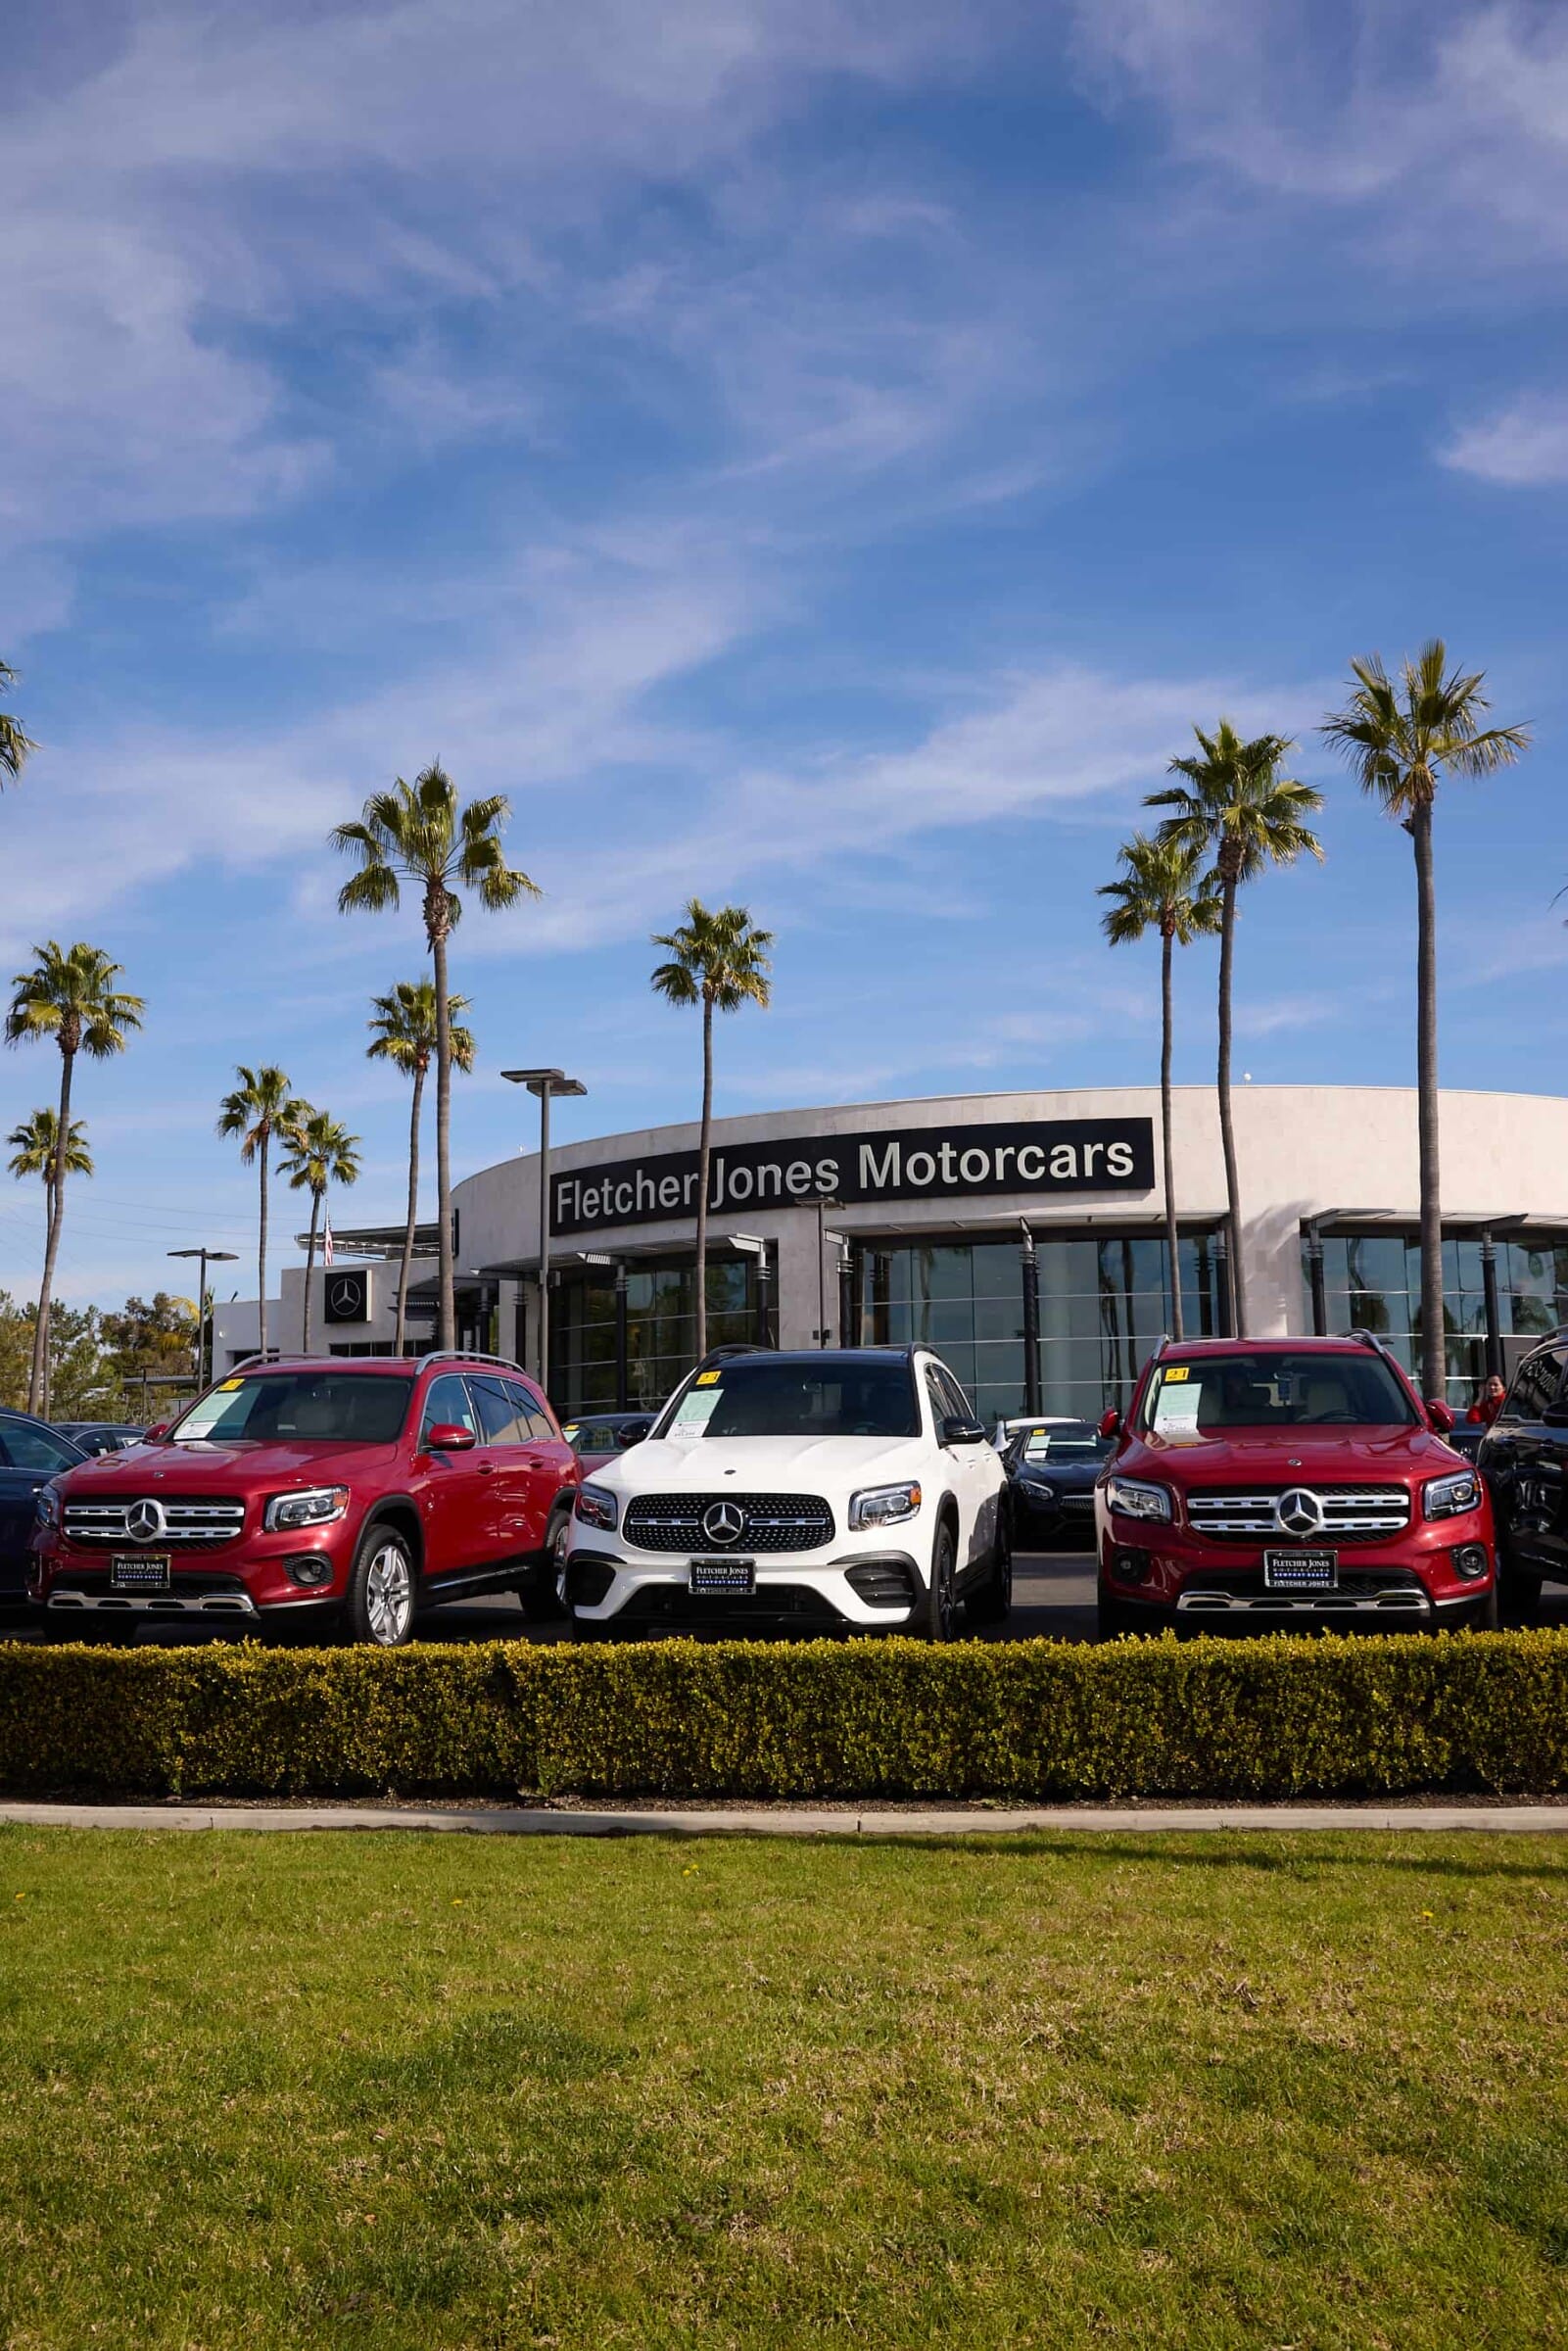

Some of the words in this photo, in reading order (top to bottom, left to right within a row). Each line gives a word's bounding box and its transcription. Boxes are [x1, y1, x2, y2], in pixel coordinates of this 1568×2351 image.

[557, 1169, 699, 1223] Fletcher
[710, 1158, 839, 1209] Jones
[859, 1141, 1134, 1189] Motorcars
[1272, 1559, 1307, 1567] FLETCHER
[1307, 1559, 1330, 1568] JONES
[696, 1566, 728, 1575] FLETCHER
[729, 1566, 749, 1576] JONES
